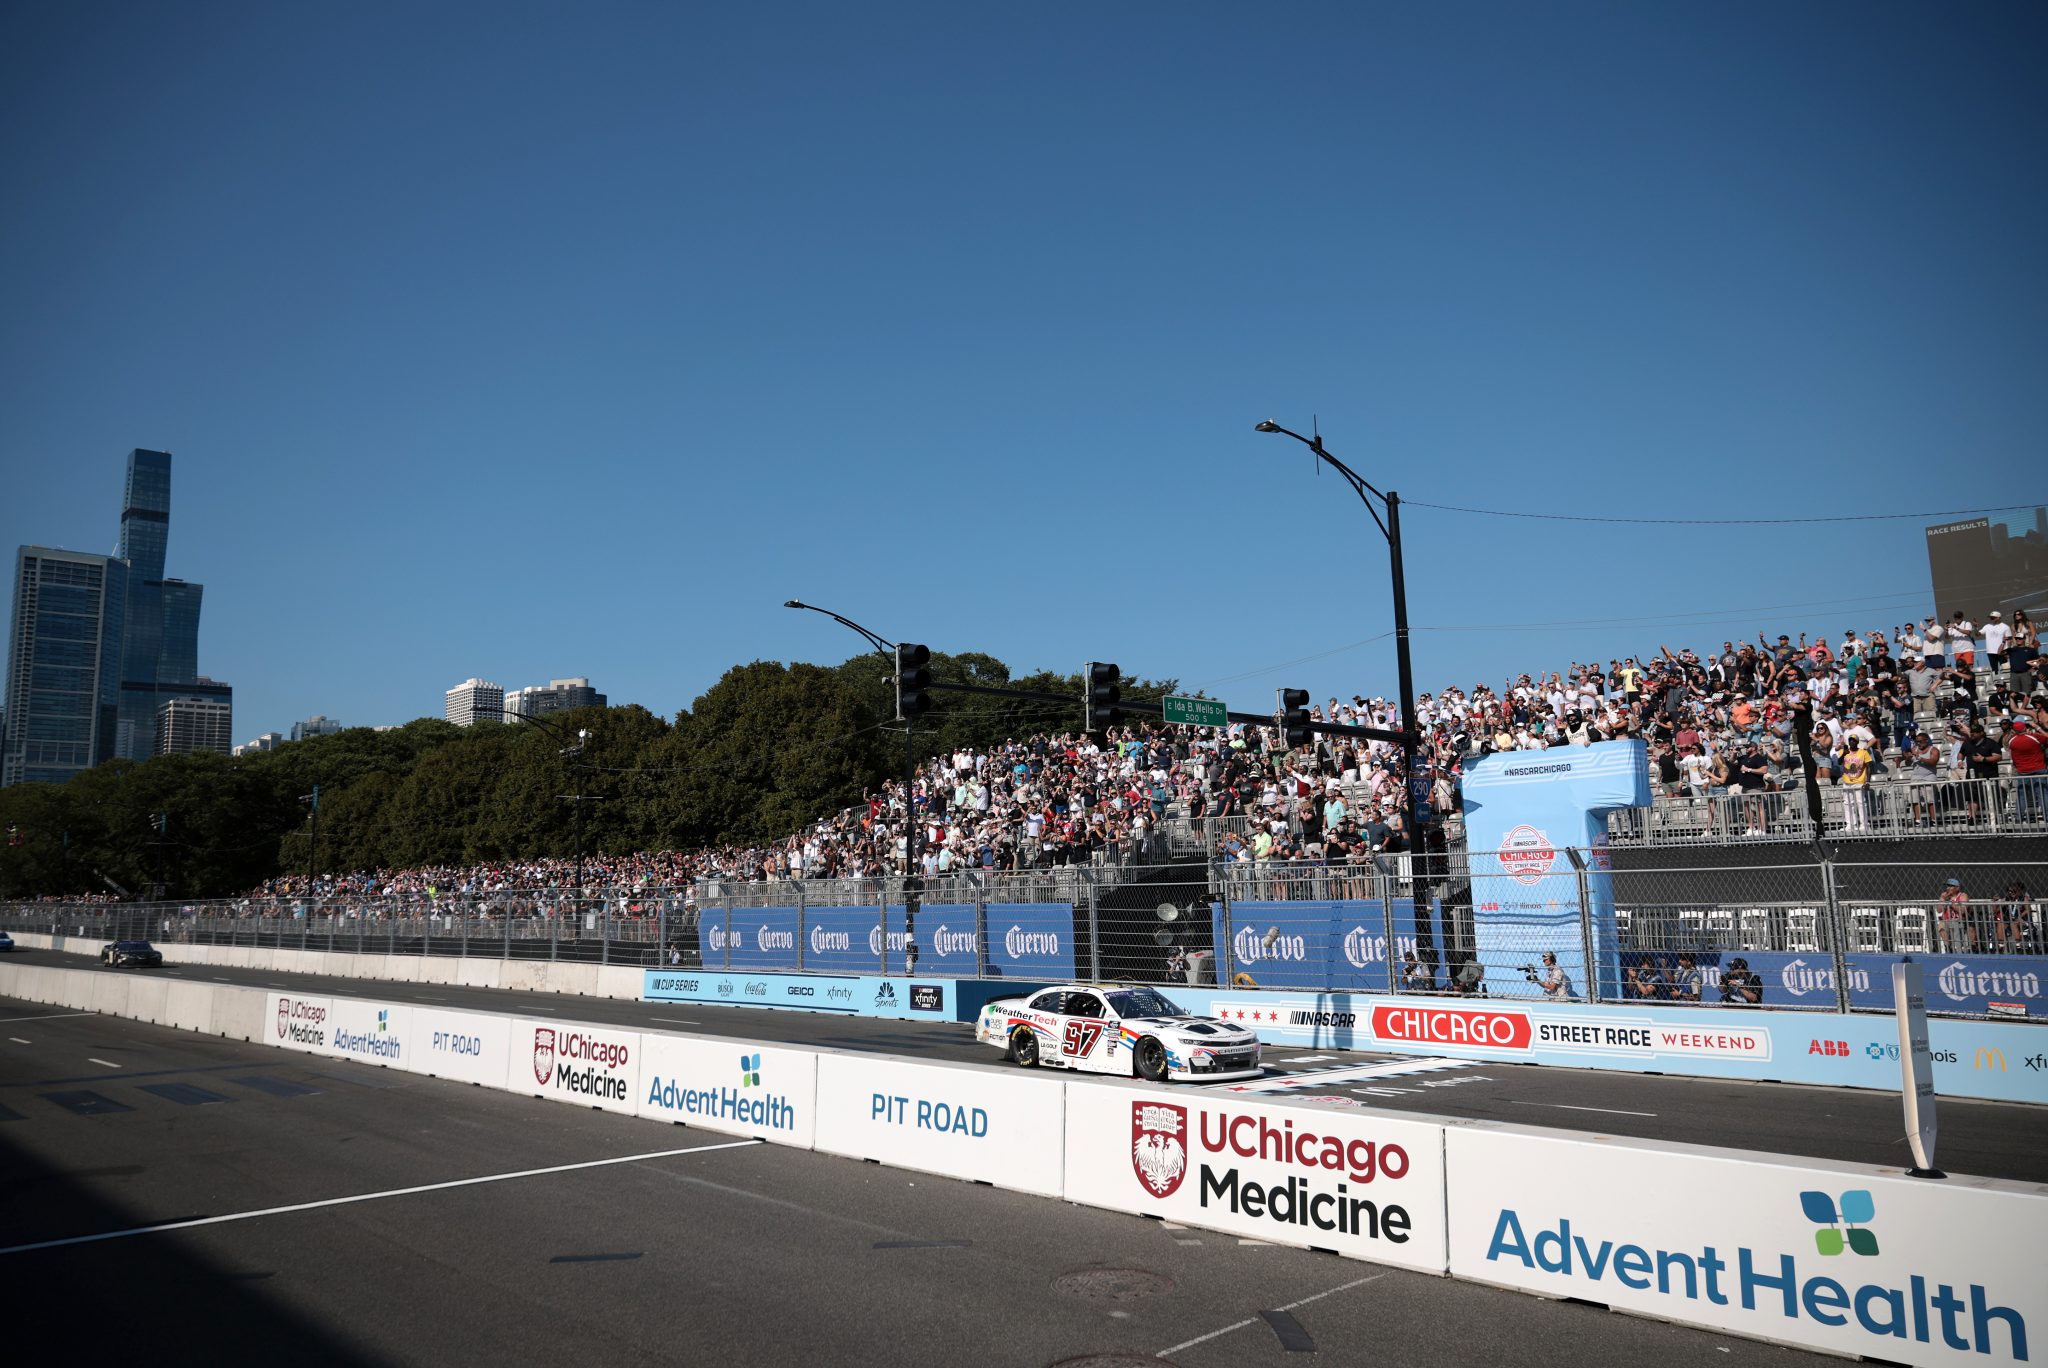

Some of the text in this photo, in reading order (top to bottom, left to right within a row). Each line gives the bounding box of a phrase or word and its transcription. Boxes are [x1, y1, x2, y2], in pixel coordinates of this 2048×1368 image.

[1928, 520, 1988, 536] RACE RESULTS
[1174, 700, 1185, 711] Ida
[1195, 703, 1213, 714] Wells
[1215, 707, 1223, 715] Dr
[1185, 713, 1200, 722] 500
[1504, 763, 1572, 777] #NASCARCHICAGO
[1413, 781, 1429, 796] 290
[1504, 849, 1549, 860] CHICAGO
[1480, 902, 1499, 911] ABB
[709, 924, 742, 951] Cuevo
[757, 924, 793, 952] Cuervo
[811, 924, 849, 954] Cuervo
[1005, 924, 1058, 959] Cuervo
[660, 978, 699, 992] CUP SERIES
[717, 984, 734, 994] BUSCH
[787, 986, 815, 996] GEICO
[826, 985, 853, 1001] xfinity
[1938, 961, 2040, 1002] Cuervo
[874, 995, 899, 1009] Sports
[915, 992, 938, 1006] xfinity
[290, 1000, 326, 1024] UChicago
[995, 1006, 1057, 1026] WeatherTech
[288, 1022, 324, 1046] Medicine
[1062, 1019, 1105, 1059] 97
[1304, 1010, 1756, 1050] NASCAR CHICAGO STREET RACE WEEKEND
[333, 1027, 401, 1059] AdventHealth
[433, 1031, 481, 1056] PIT ROAD
[559, 1032, 628, 1069] UChicago
[1808, 1039, 1850, 1057] ABB
[556, 1063, 627, 1101] Medicine
[648, 1076, 794, 1131] AdventHealth
[872, 1093, 989, 1138] PIT ROAD
[1200, 1110, 1410, 1184] UChicago
[1200, 1163, 1412, 1244] Medicine
[1486, 1208, 2029, 1363] AdventHealth
